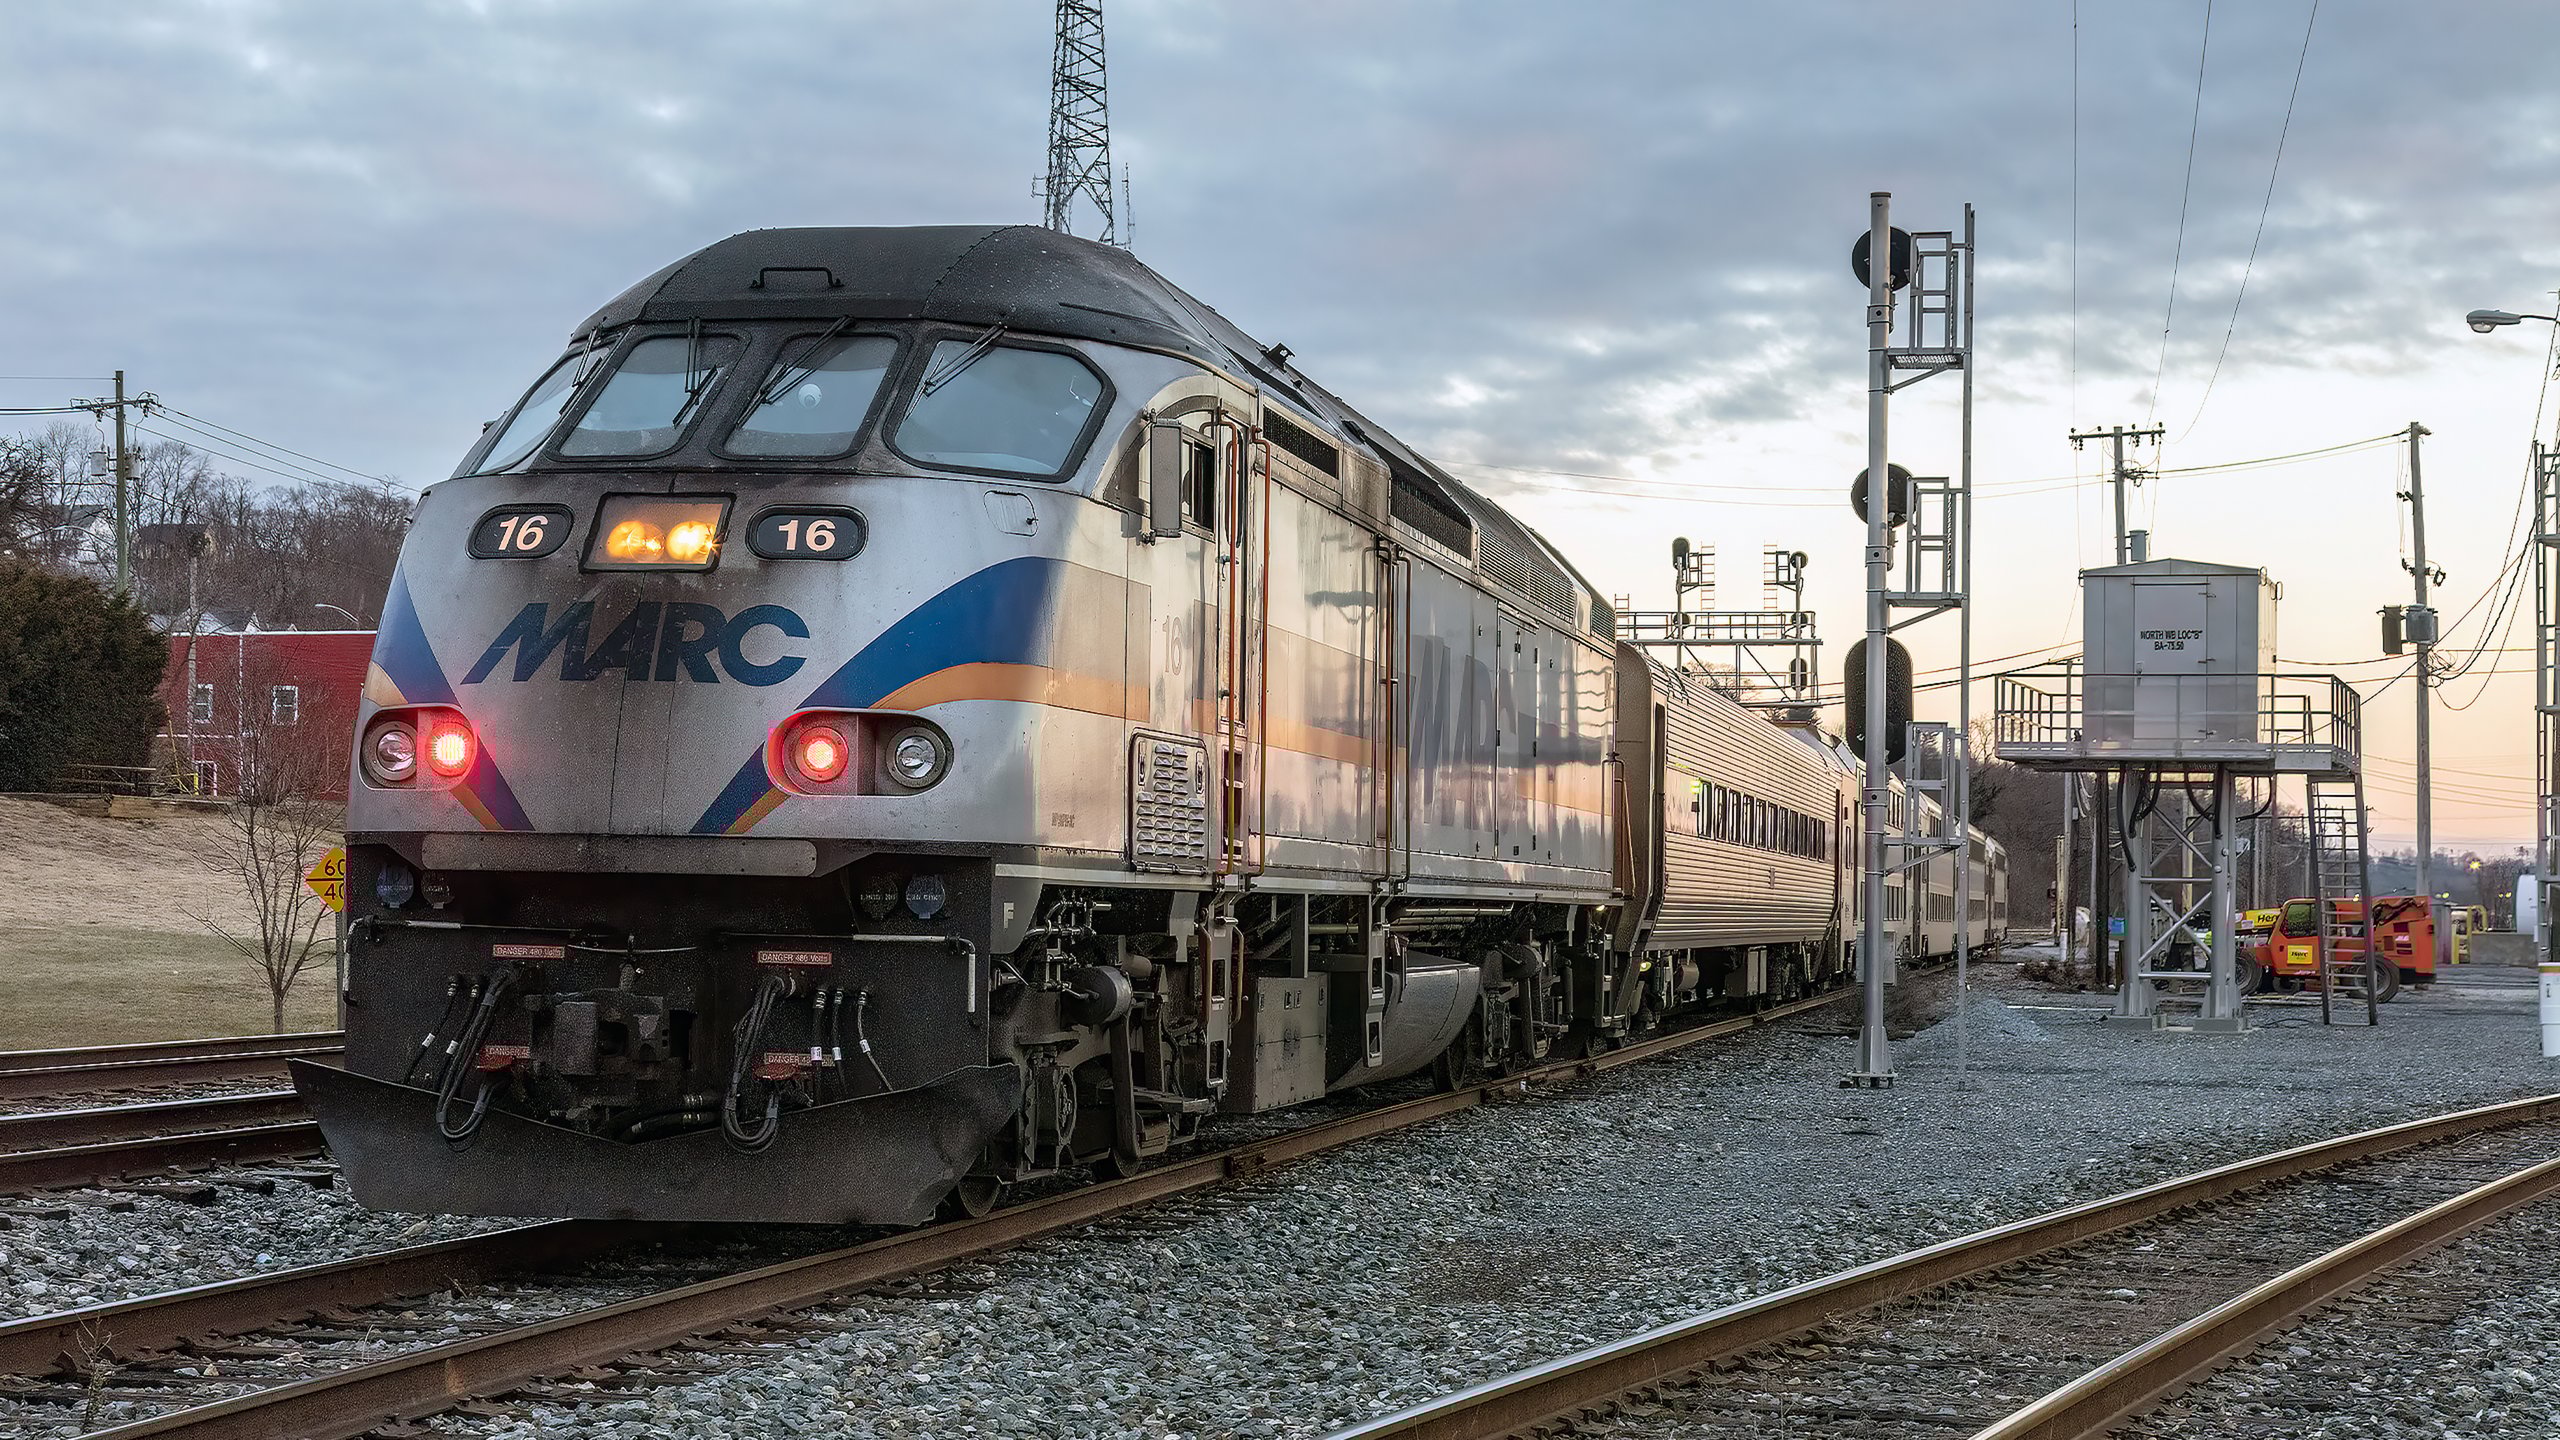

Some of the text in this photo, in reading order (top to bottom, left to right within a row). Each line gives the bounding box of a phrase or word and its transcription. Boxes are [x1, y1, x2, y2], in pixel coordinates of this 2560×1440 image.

[498, 515, 548, 551] 16
[778, 519, 836, 552] 16
[460, 601, 810, 687] MARC
[1162, 614, 1182, 676] 16
[2140, 630, 2164, 640] NORTH
[1003, 902, 1015, 929] F
[497, 946, 528, 955] DANGER
[762, 953, 793, 962] DANGER
[768, 1055, 800, 1064] DANGER
